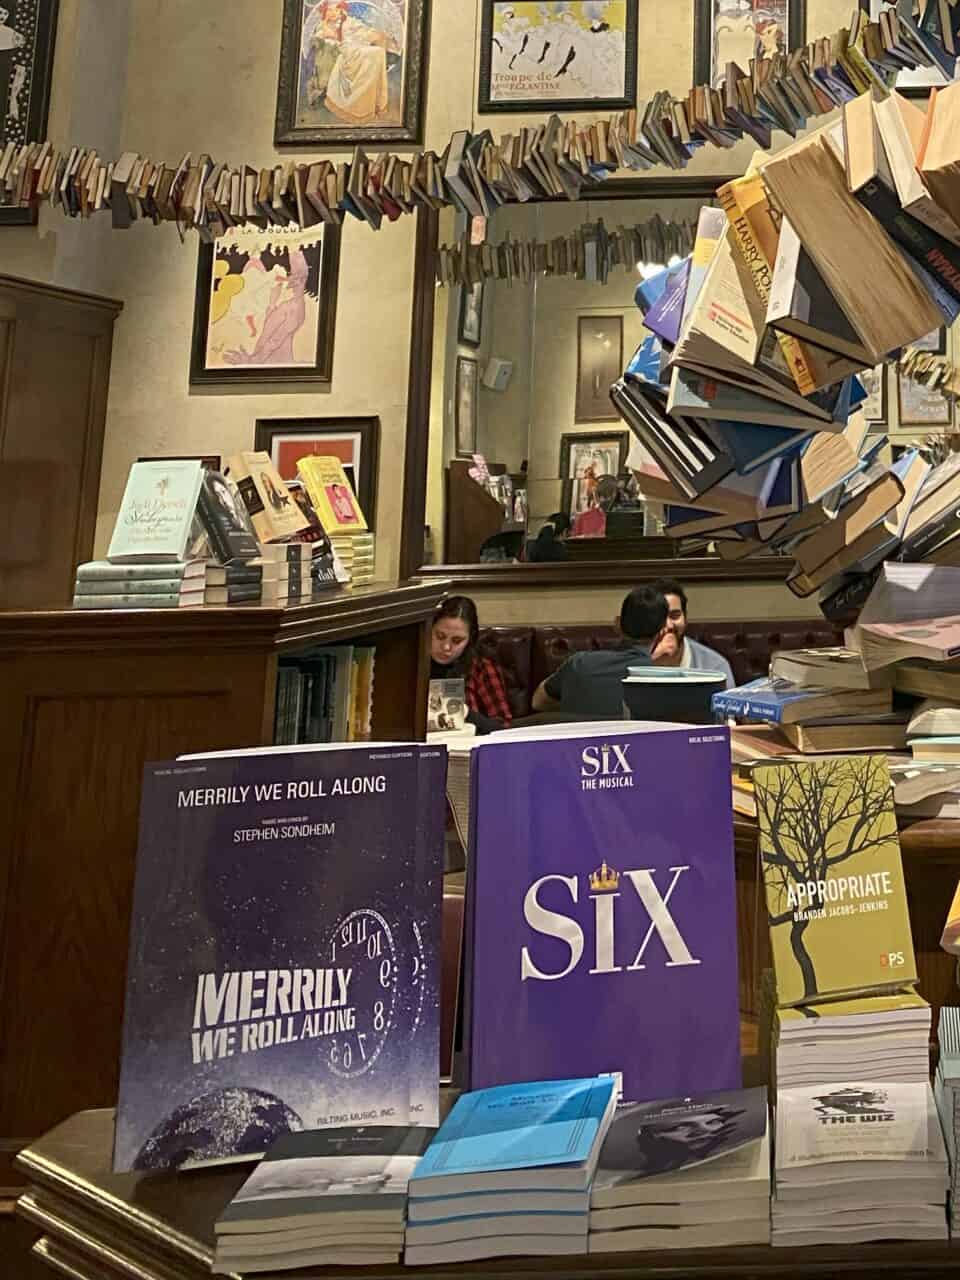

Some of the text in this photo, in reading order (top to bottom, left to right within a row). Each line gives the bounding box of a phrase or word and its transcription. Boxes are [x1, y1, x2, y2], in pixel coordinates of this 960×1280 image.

[536, 71, 552, 81] de
[731, 215, 765, 264] HARRY
[581, 743, 632, 776] SIX
[177, 775, 386, 808] MERRILY WE ROLL ALONG
[581, 776, 634, 791] THE MUSICAL
[233, 822, 336, 843] STEPHEN SONDHEIM
[787, 871, 894, 909] APPROPRIATE
[520, 860, 701, 982] SIX
[192, 968, 352, 1029] MERRILY
[191, 1008, 356, 1064] WE ROLL ALONG
[817, 1113, 896, 1125] THE WIZ
